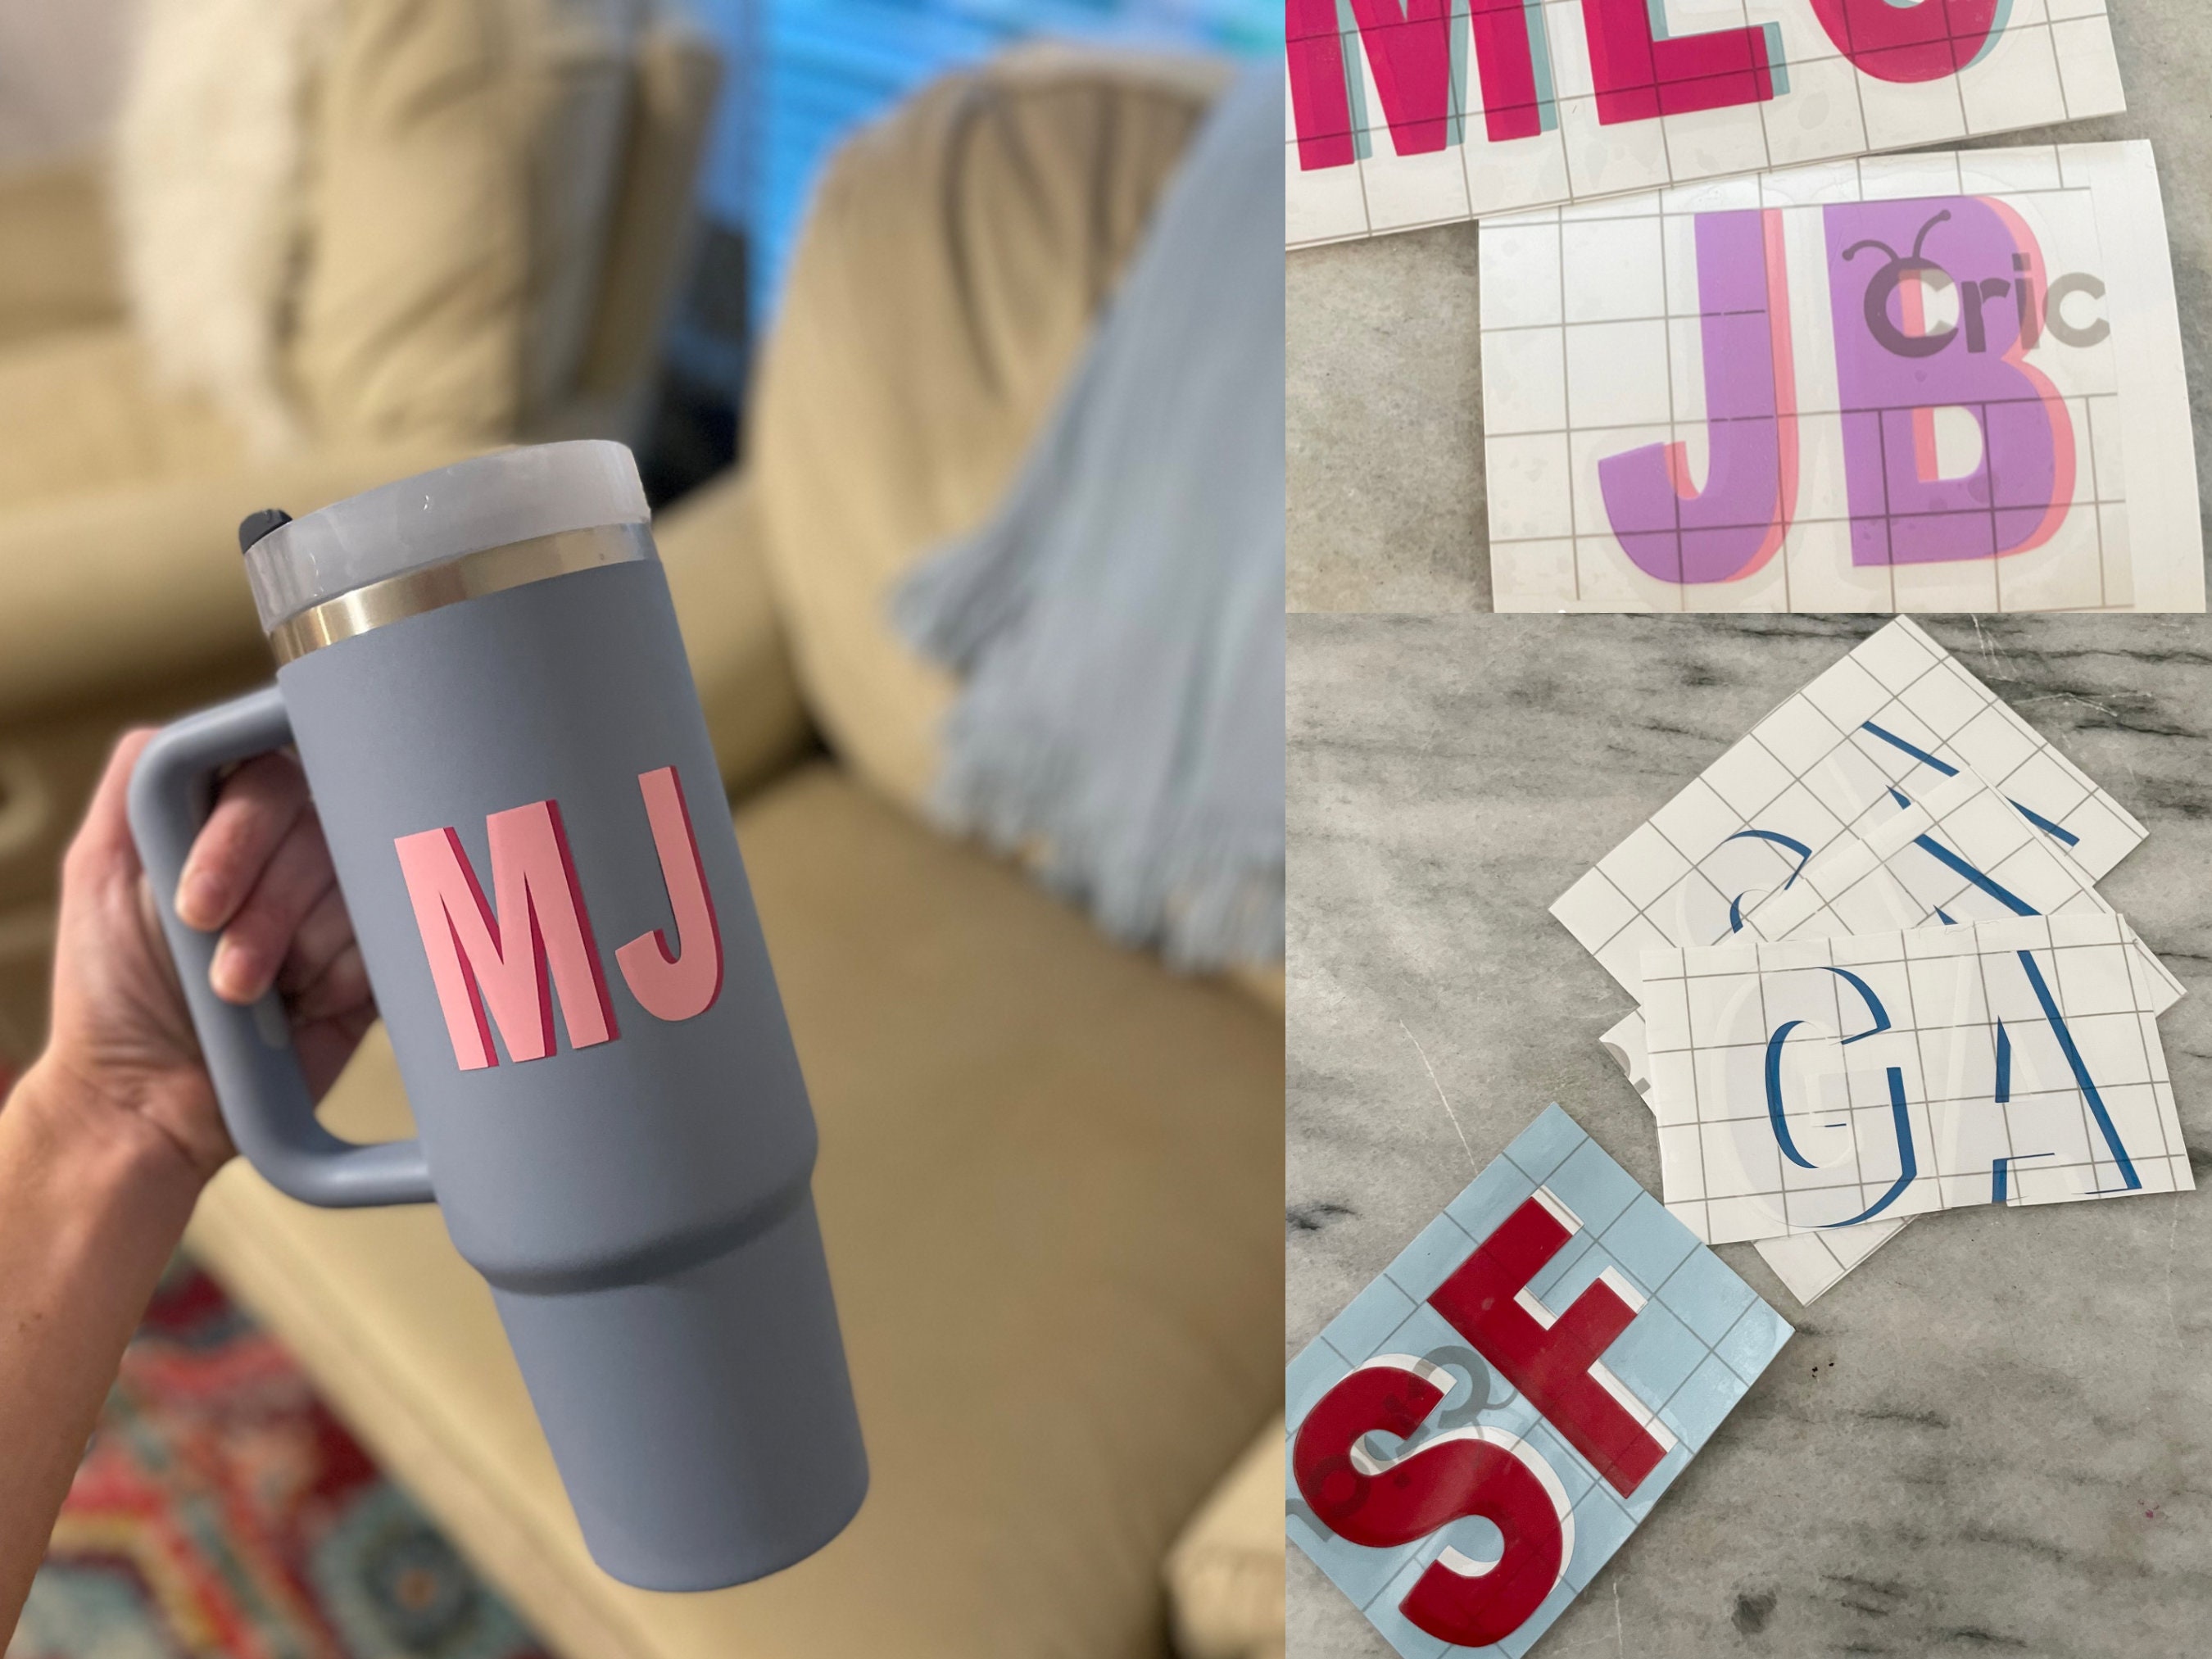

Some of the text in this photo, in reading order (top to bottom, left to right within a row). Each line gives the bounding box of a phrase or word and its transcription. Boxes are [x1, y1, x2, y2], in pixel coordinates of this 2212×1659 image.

[1598, 195, 2077, 584] JB
[394, 765, 724, 1071] MJ
[1716, 949, 2142, 1228] GA
[1292, 1185, 1679, 1648] SF
